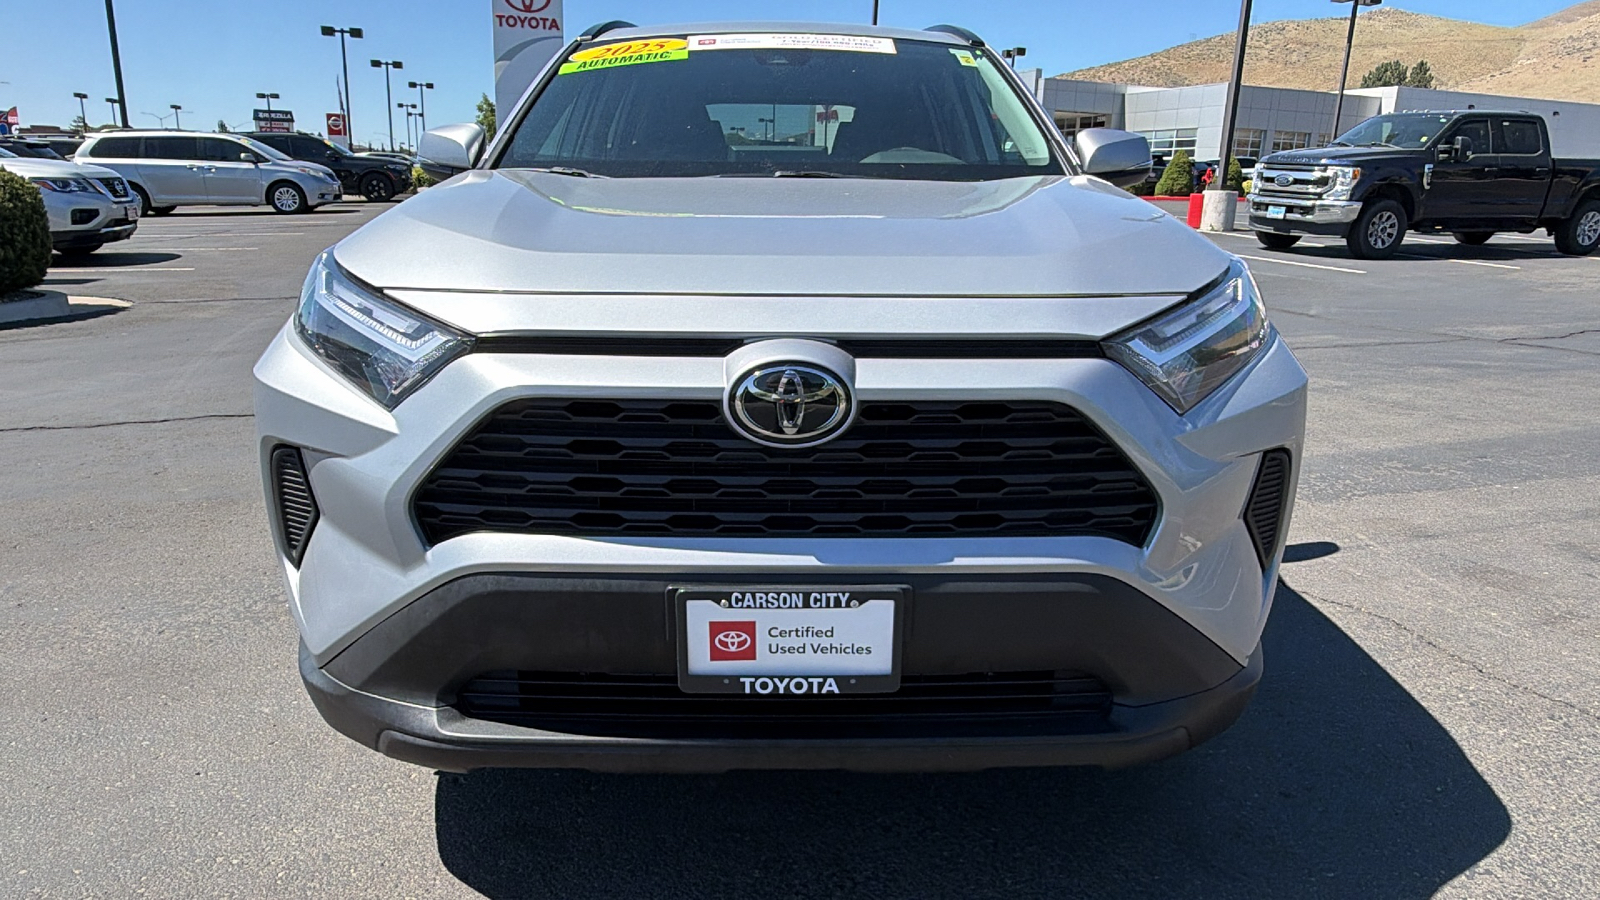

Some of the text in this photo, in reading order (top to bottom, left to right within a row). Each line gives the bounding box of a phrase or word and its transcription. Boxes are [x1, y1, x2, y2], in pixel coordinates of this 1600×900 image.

[495, 14, 560, 31] TOYOTA
[593, 40, 671, 59] 2025
[576, 51, 673, 70] AUTOMATIC
[730, 591, 850, 608] CARSON CITY
[767, 626, 834, 638] Certified
[768, 643, 872, 655] Used Vehicles
[739, 677, 840, 694] TOYOTA
